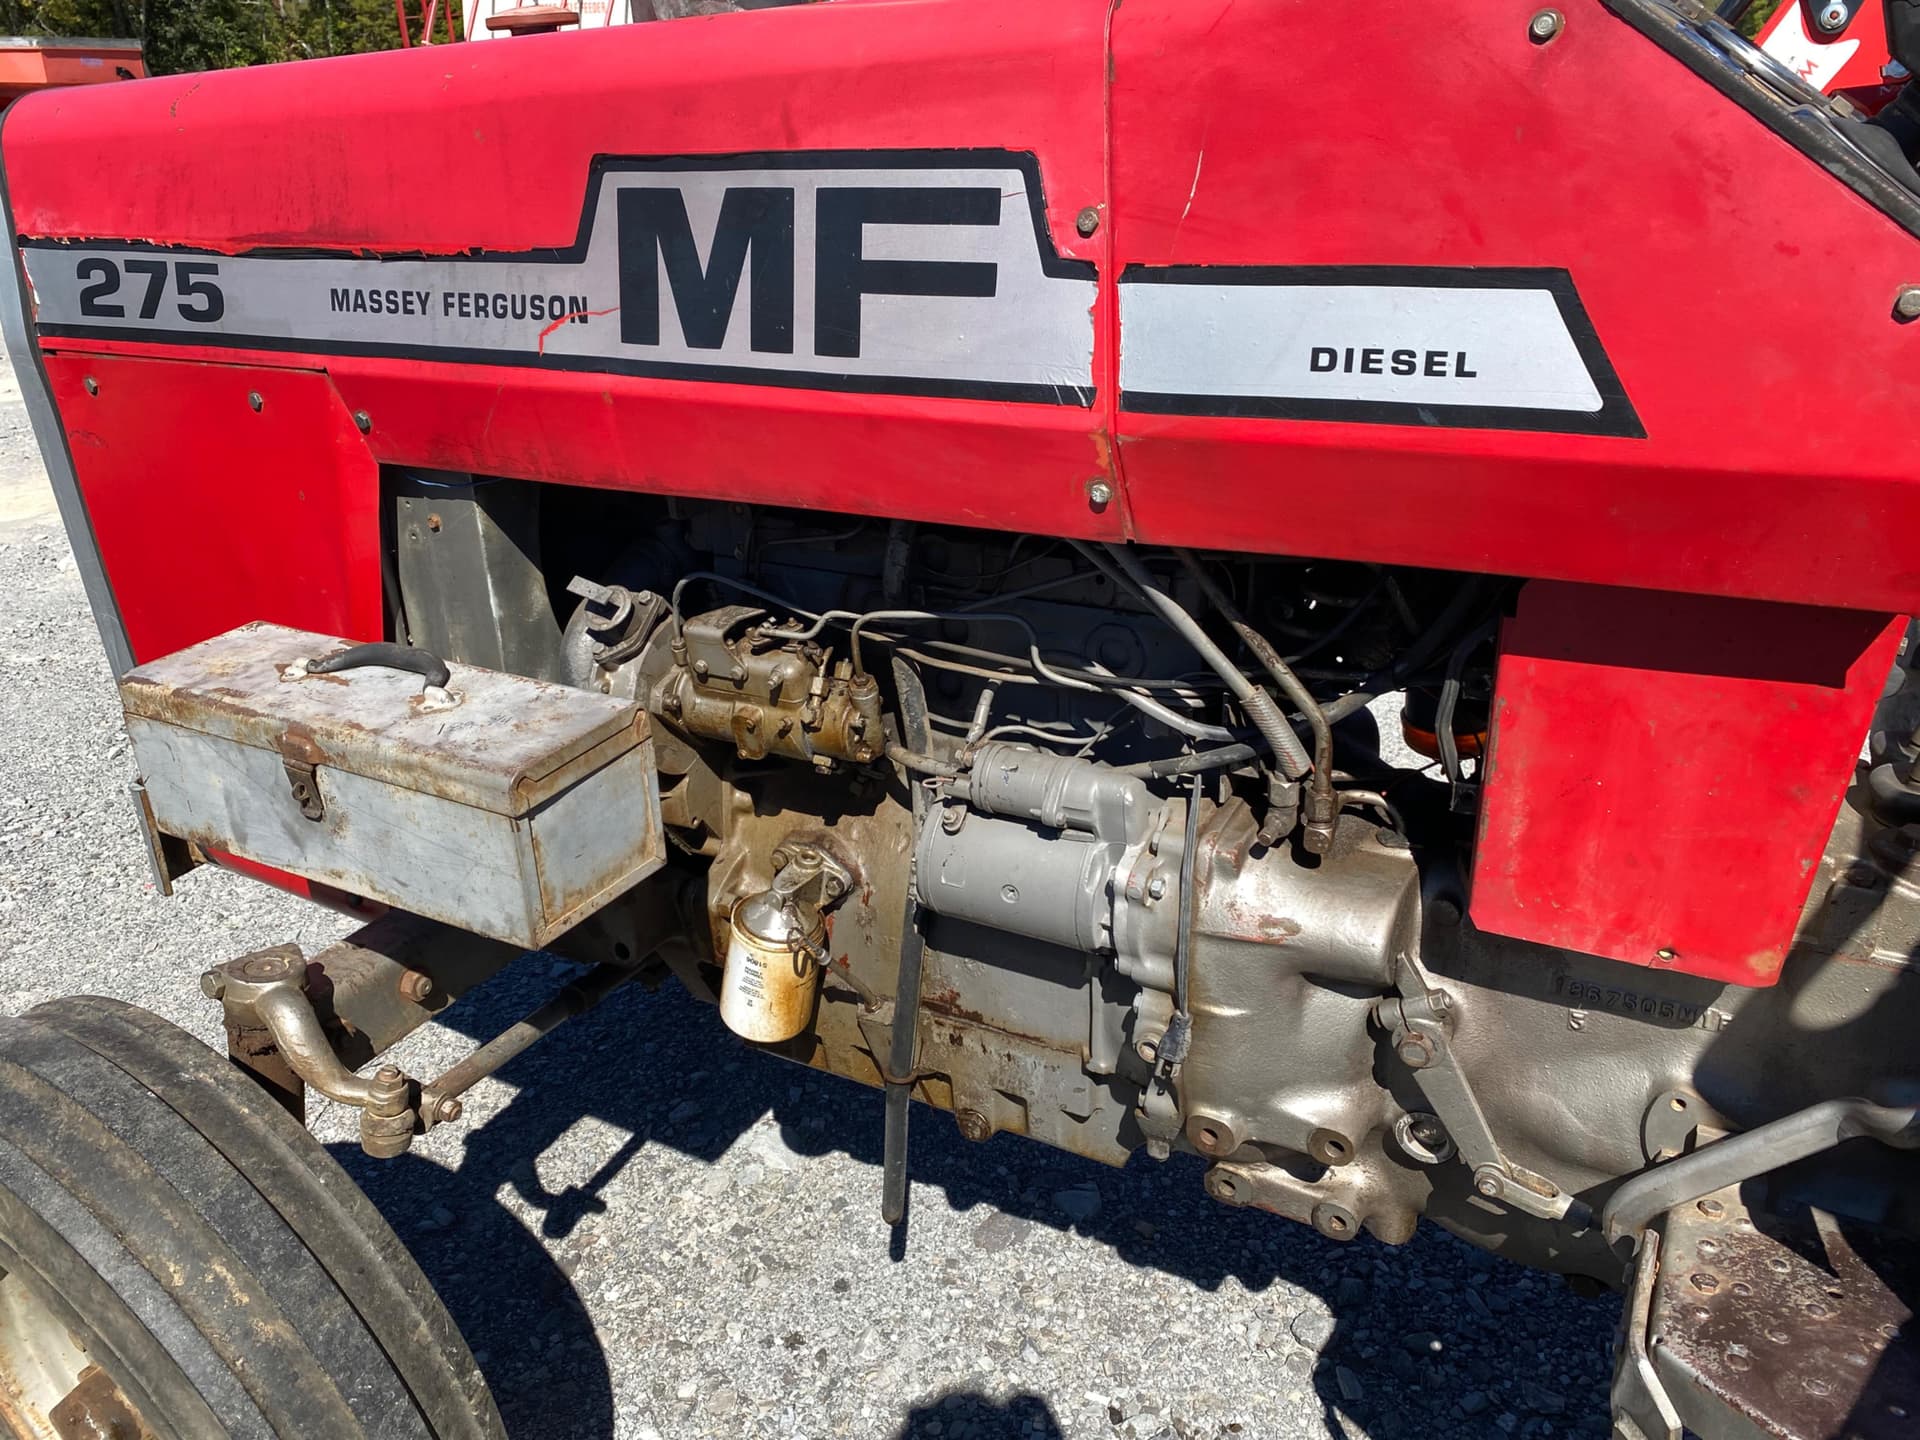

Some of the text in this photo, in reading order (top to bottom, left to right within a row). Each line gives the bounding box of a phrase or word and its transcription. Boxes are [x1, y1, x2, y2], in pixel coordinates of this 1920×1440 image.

[76, 257, 225, 323] 275
[616, 187, 1002, 359] MF
[330, 288, 589, 324] MASSEY FERGUSON
[1310, 346, 1477, 378] DIESEL
